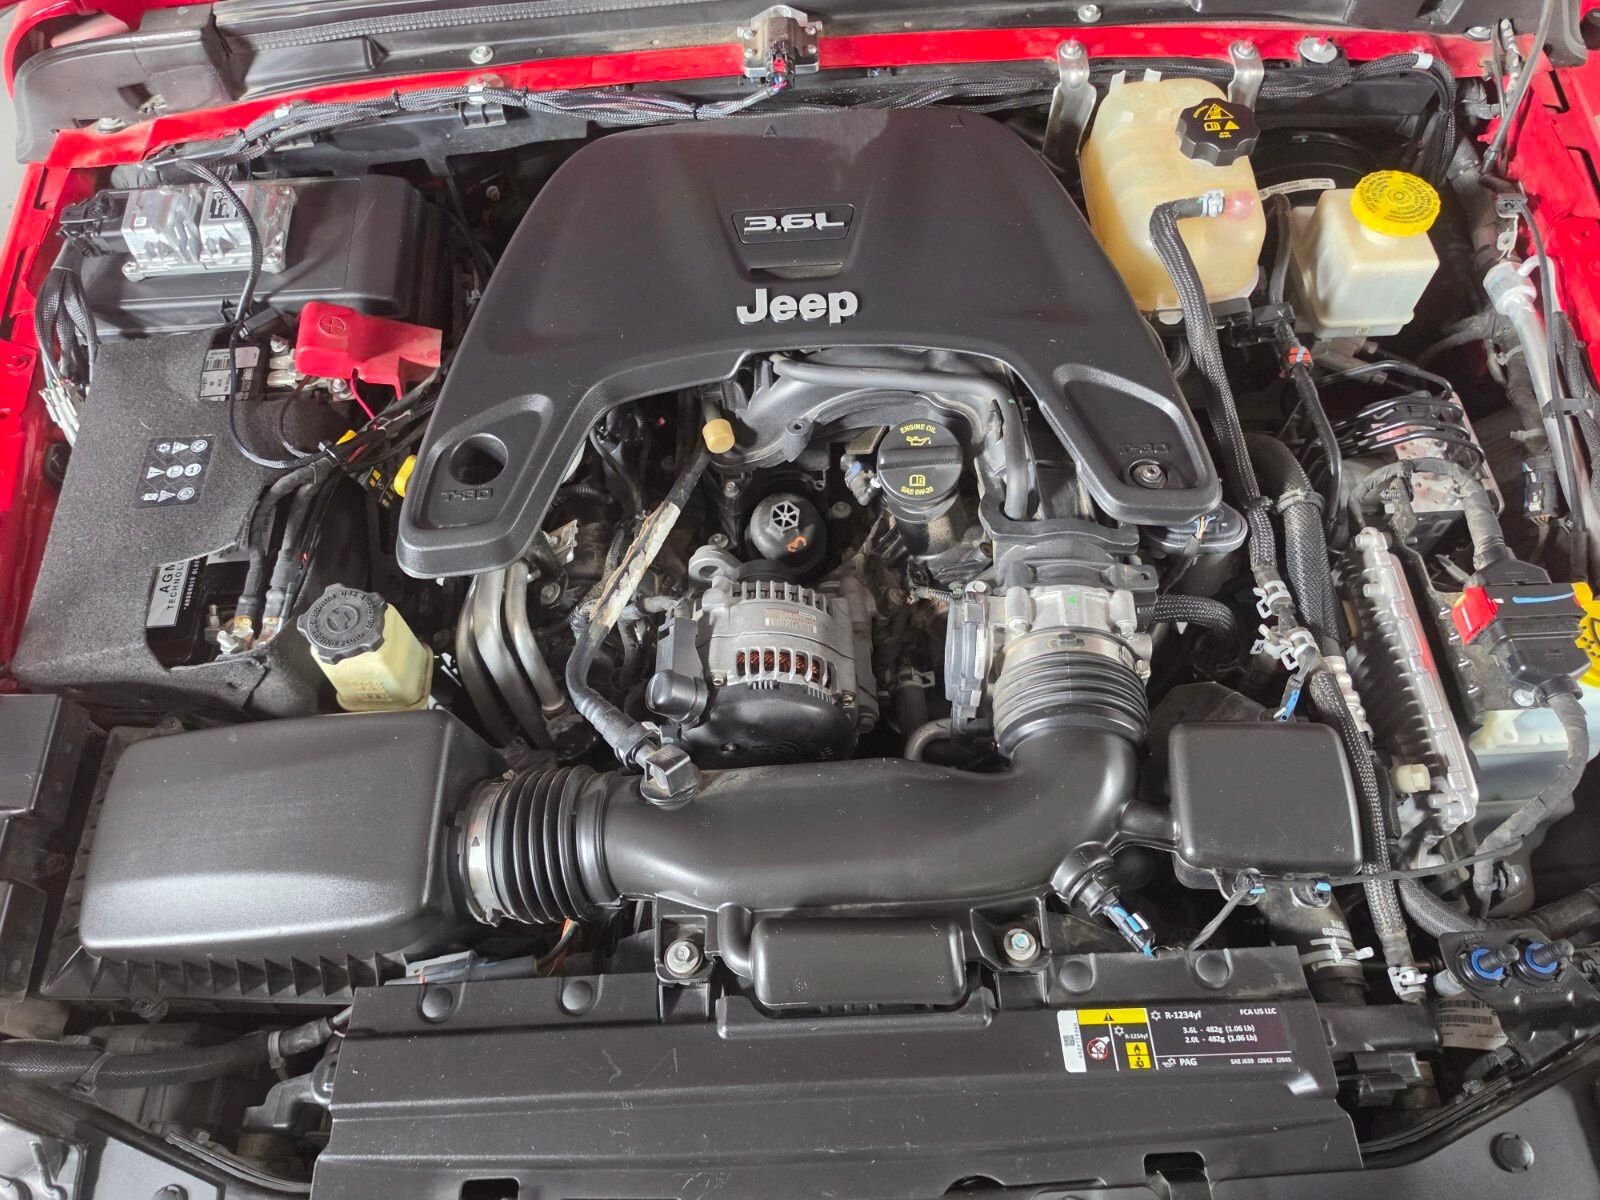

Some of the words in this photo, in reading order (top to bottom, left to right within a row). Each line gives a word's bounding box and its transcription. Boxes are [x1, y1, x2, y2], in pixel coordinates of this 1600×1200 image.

[744, 212, 844, 233] 3.6L
[736, 288, 858, 325] Jeep
[900, 423, 926, 434] ENGINE
[926, 425, 937, 434] OIL
[900, 485, 914, 495] SAE
[1164, 1009, 1202, 1020] R-1234yf
[1239, 1008, 1254, 1016] FCA
[1254, 1007, 1264, 1015] US
[1264, 1007, 1277, 1015] LLC
[1182, 1026, 1198, 1034] 3.6L
[1205, 1025, 1223, 1034] 482g
[1184, 1036, 1200, 1044] 2.0L
[1179, 1057, 1198, 1066] PAG
